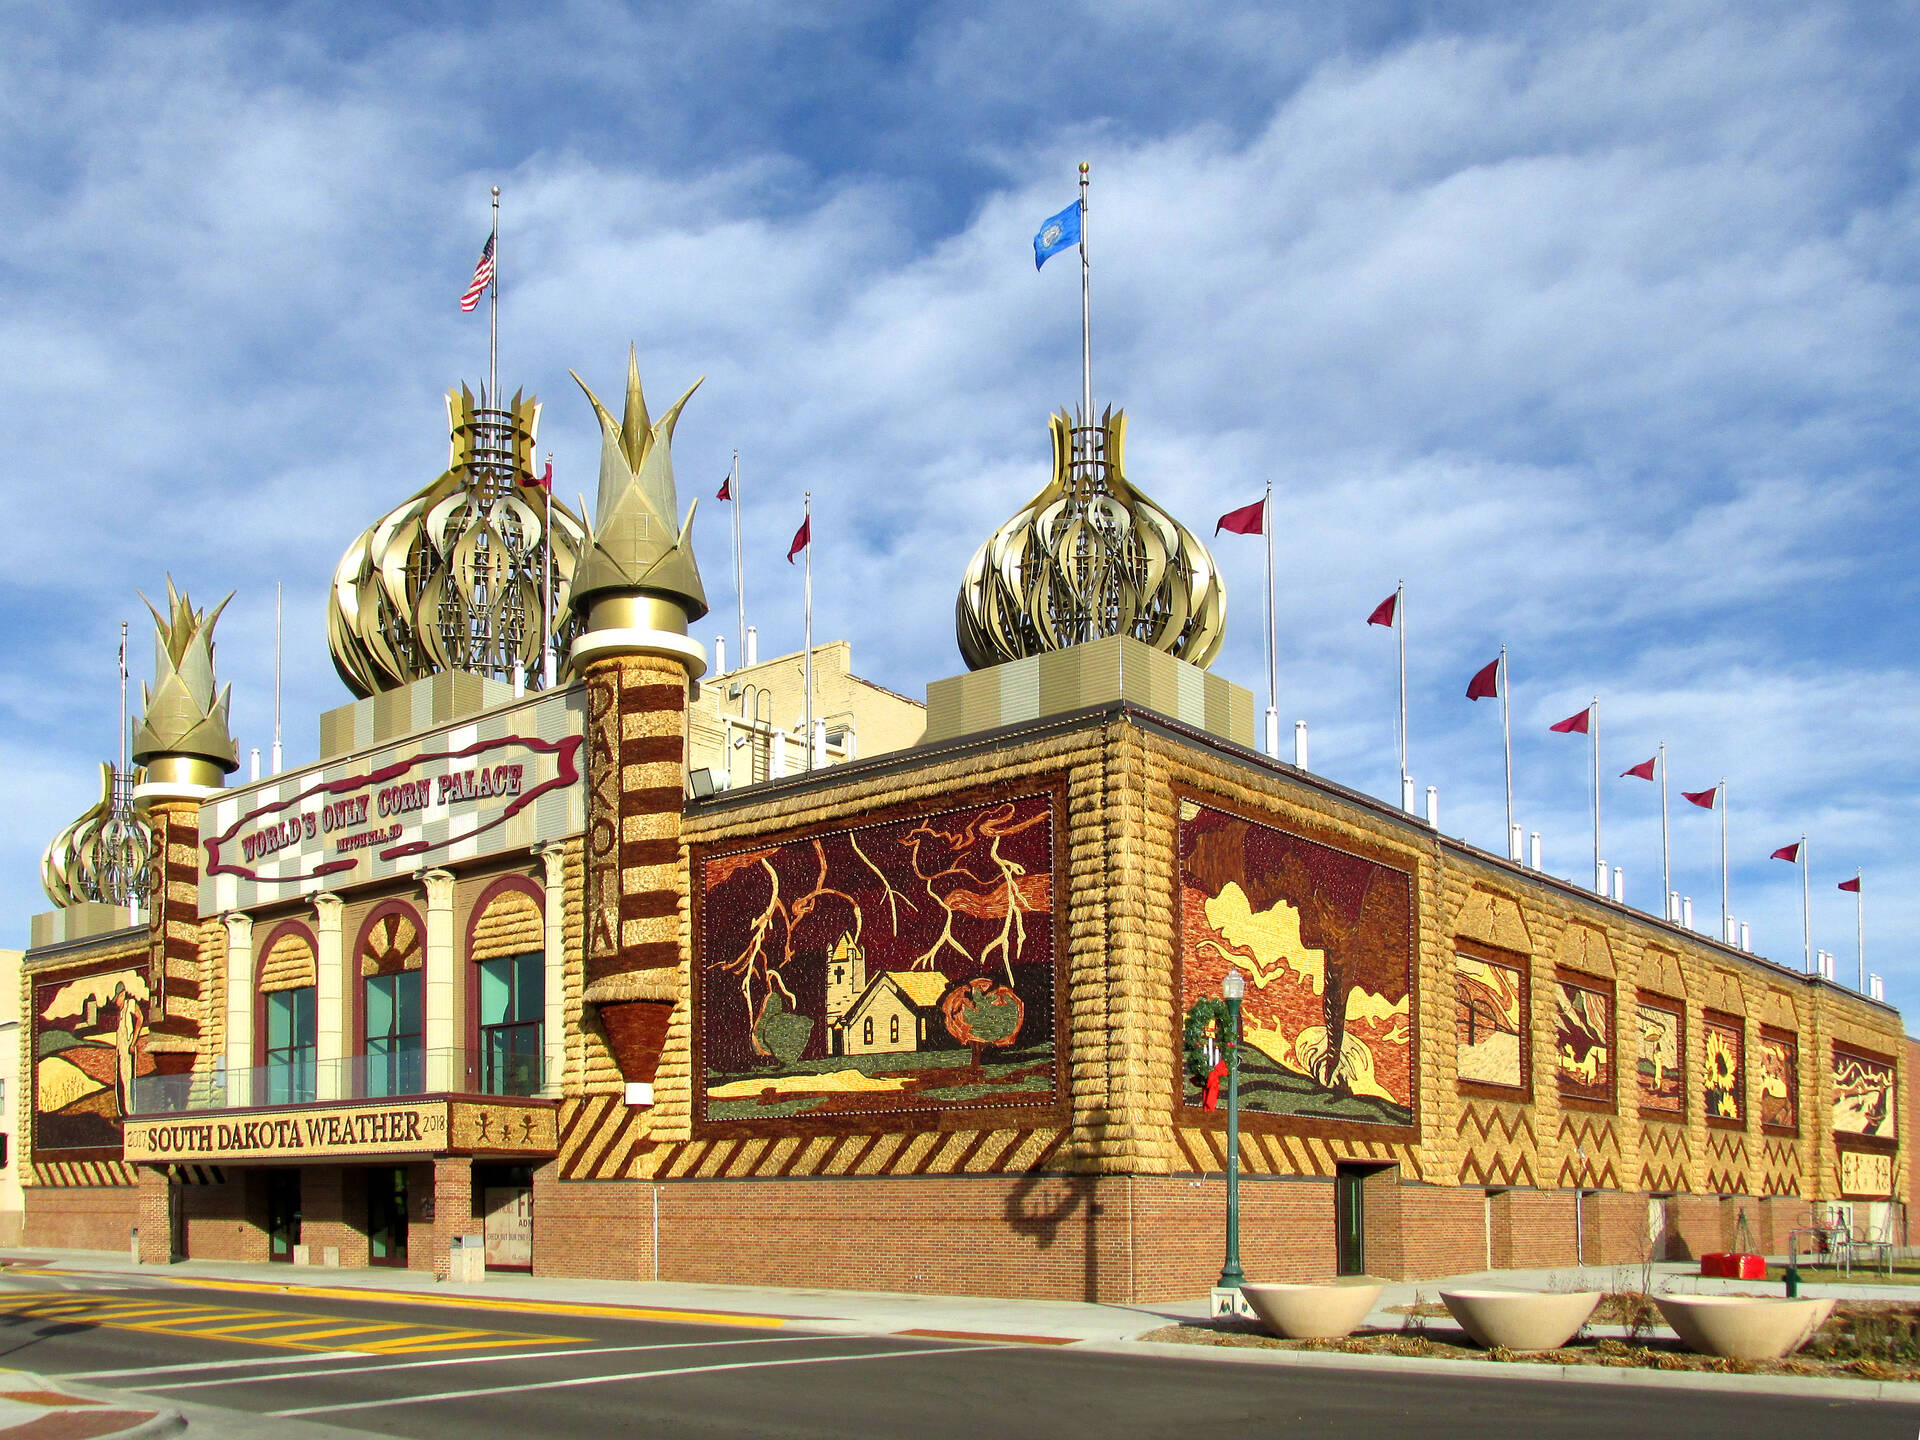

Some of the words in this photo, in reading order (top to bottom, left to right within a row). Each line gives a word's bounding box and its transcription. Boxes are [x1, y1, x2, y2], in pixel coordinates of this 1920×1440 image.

[242, 811, 317, 864] WORLD'S
[323, 794, 370, 834] ONLY
[378, 778, 431, 818] CORN
[437, 764, 523, 806] PALACE
[589, 680, 615, 953] DAKOTA
[127, 1130, 147, 1148] 2017
[148, 1125, 214, 1152] SOUTH
[217, 1119, 304, 1150] DAKOTA
[306, 1111, 423, 1147] WEATHER
[423, 1115, 445, 1133] 2018
